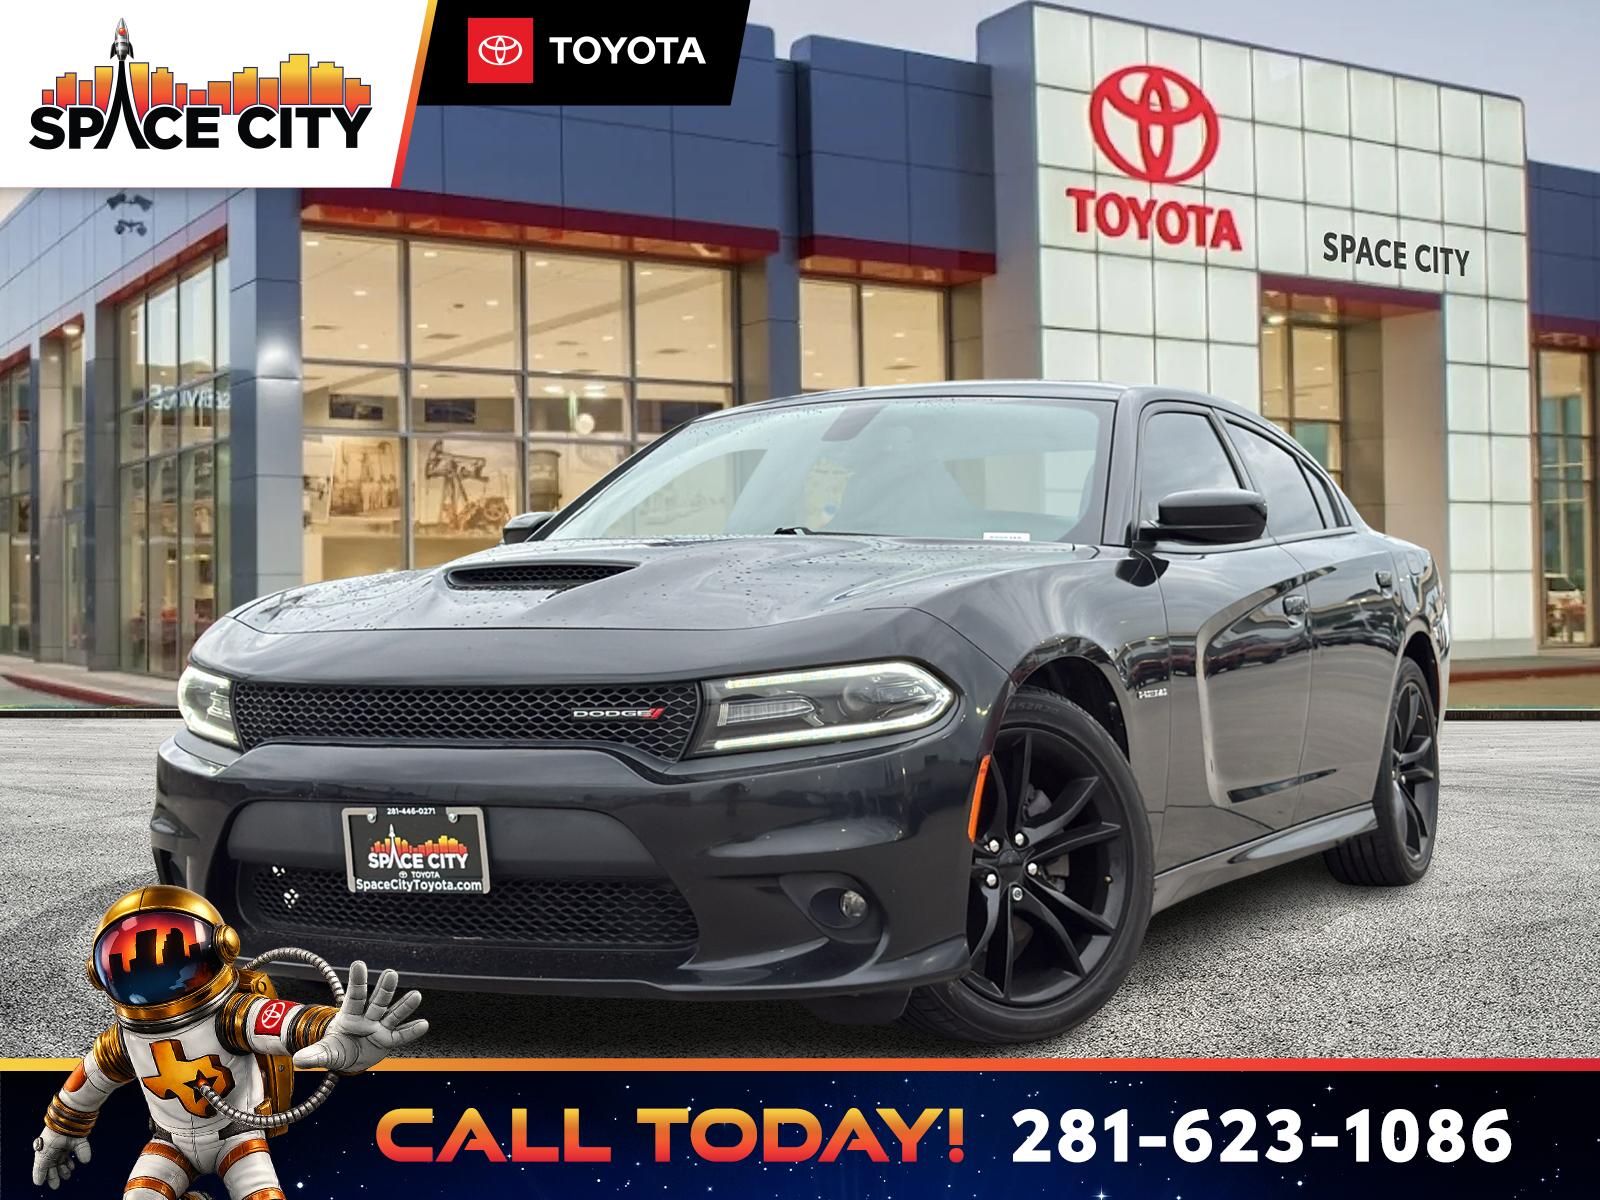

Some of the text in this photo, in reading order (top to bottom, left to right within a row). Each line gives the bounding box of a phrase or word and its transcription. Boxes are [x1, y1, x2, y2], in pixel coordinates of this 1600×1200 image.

[1066, 187, 1242, 250] TOYOTA
[1323, 232, 1470, 277] SPACE CITY
[573, 709, 652, 718] DODGE
[386, 807, 436, 815] 281-446-0271
[368, 852, 468, 869] SPACE CITY
[410, 871, 440, 879] TOYOTA
[356, 878, 482, 893] SpaceCityToyota.com
